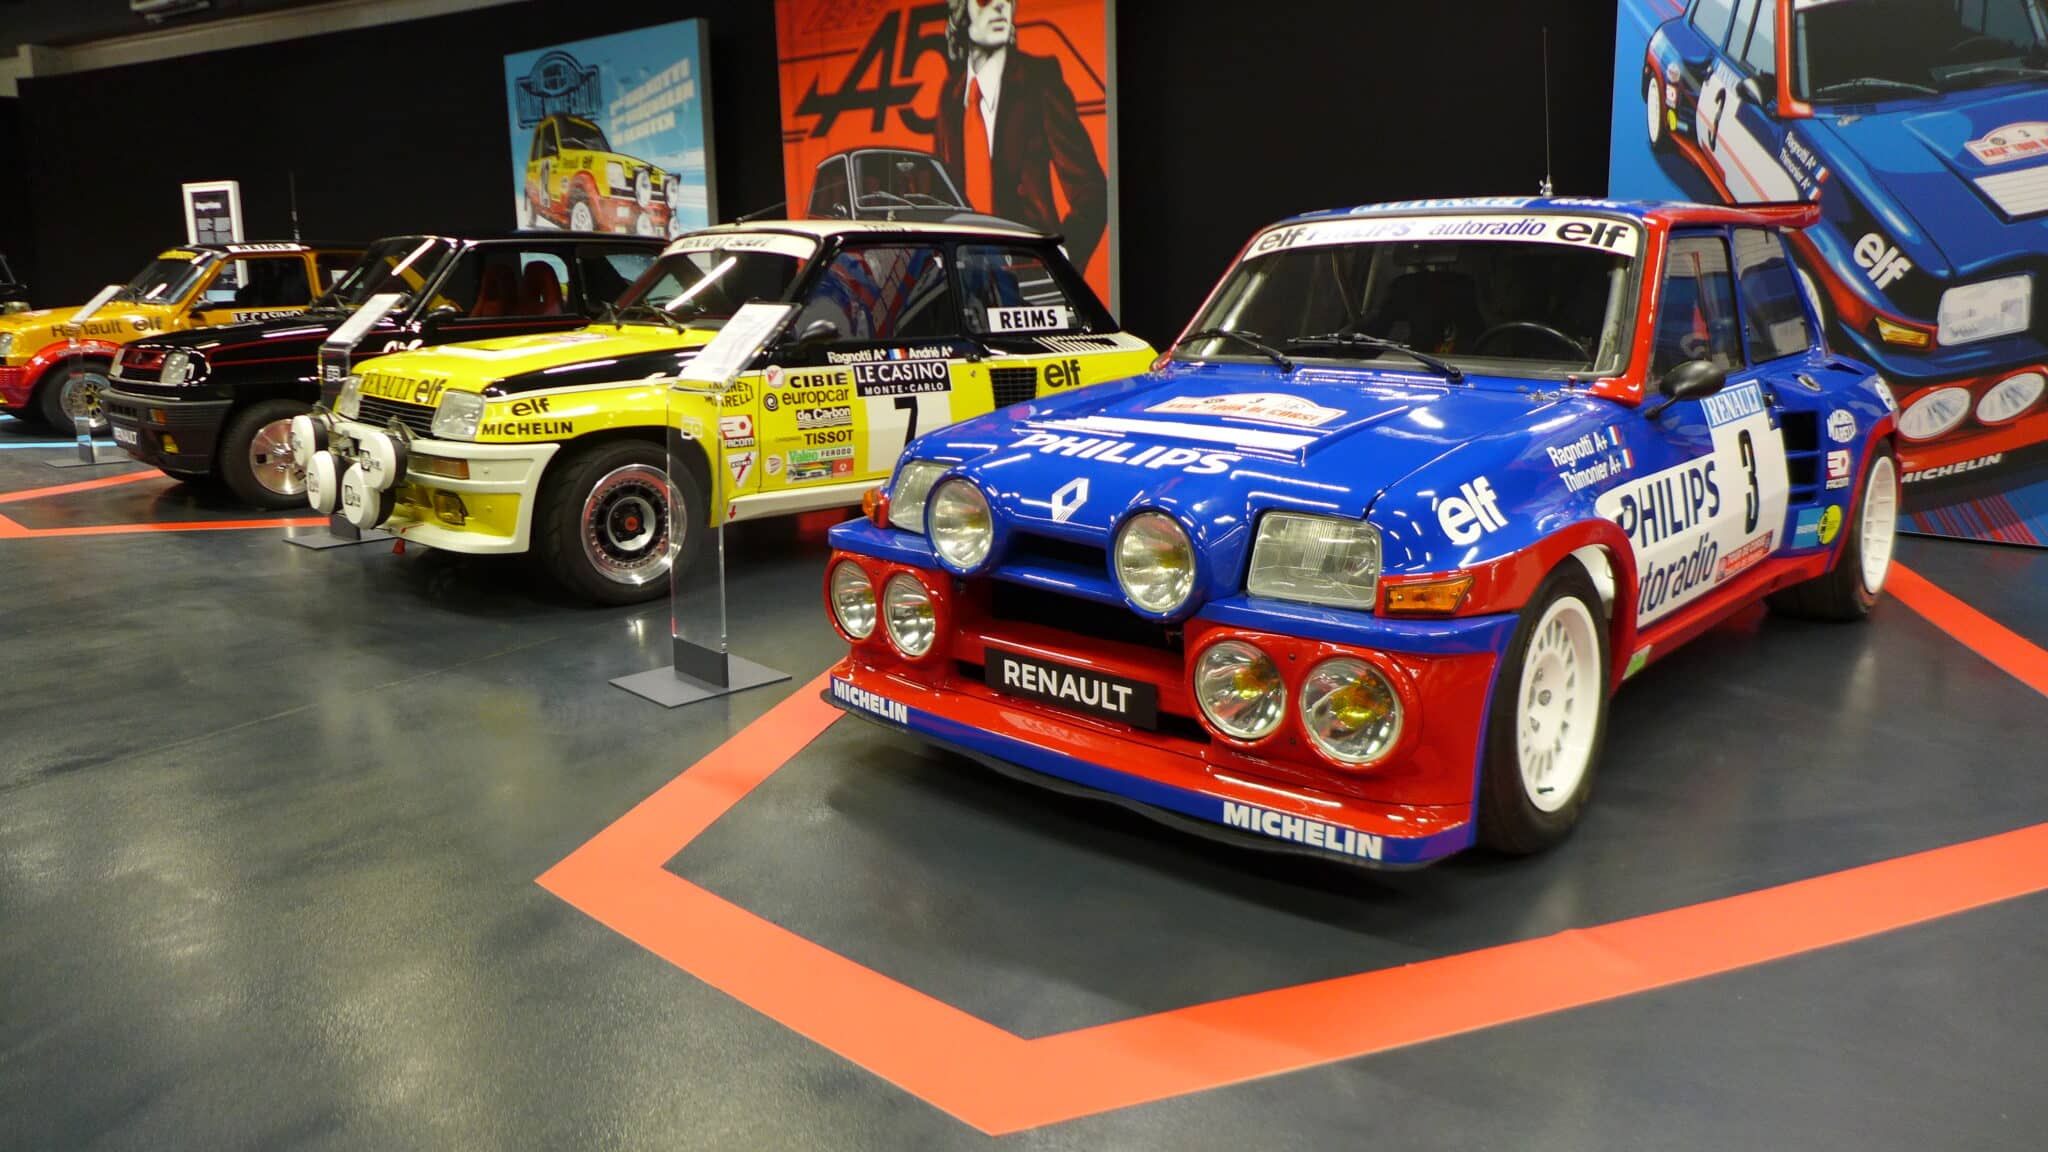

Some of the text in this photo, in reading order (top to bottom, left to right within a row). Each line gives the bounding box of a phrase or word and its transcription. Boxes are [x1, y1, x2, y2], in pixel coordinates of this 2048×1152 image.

[1257, 226, 1307, 252] elf
[1428, 218, 1547, 238] autoradio
[1556, 222, 1628, 248] elf
[1854, 233, 1912, 290] elf
[133, 316, 163, 332] elf
[1000, 308, 1058, 330] REIMS
[827, 351, 872, 365] Ragnotti
[856, 362, 946, 383] LE CASINO
[1044, 359, 1080, 387] elf
[360, 372, 447, 406] RENAULT elf
[790, 372, 848, 387] CIBIE
[512, 398, 551, 416] elf
[782, 387, 848, 407] europcar
[797, 406, 851, 421] de Carbon
[1709, 384, 1759, 425] RENAULT
[482, 421, 573, 436] MICHELIN
[805, 430, 854, 445] TISSOT
[895, 396, 918, 446] 7
[789, 448, 852, 462] Valeo FERODO
[1009, 432, 1243, 474] PHILIPS
[1546, 431, 1608, 467] Ragnotti A+
[1560, 454, 1622, 493] Thimonier A+
[1737, 429, 1760, 534] 3
[1437, 476, 1508, 546] elf
[1616, 460, 1721, 548] PHILIPS
[834, 678, 908, 724] MICHELIN
[1003, 660, 1132, 713] RENAULT
[1222, 801, 1383, 861] MICHELIN
